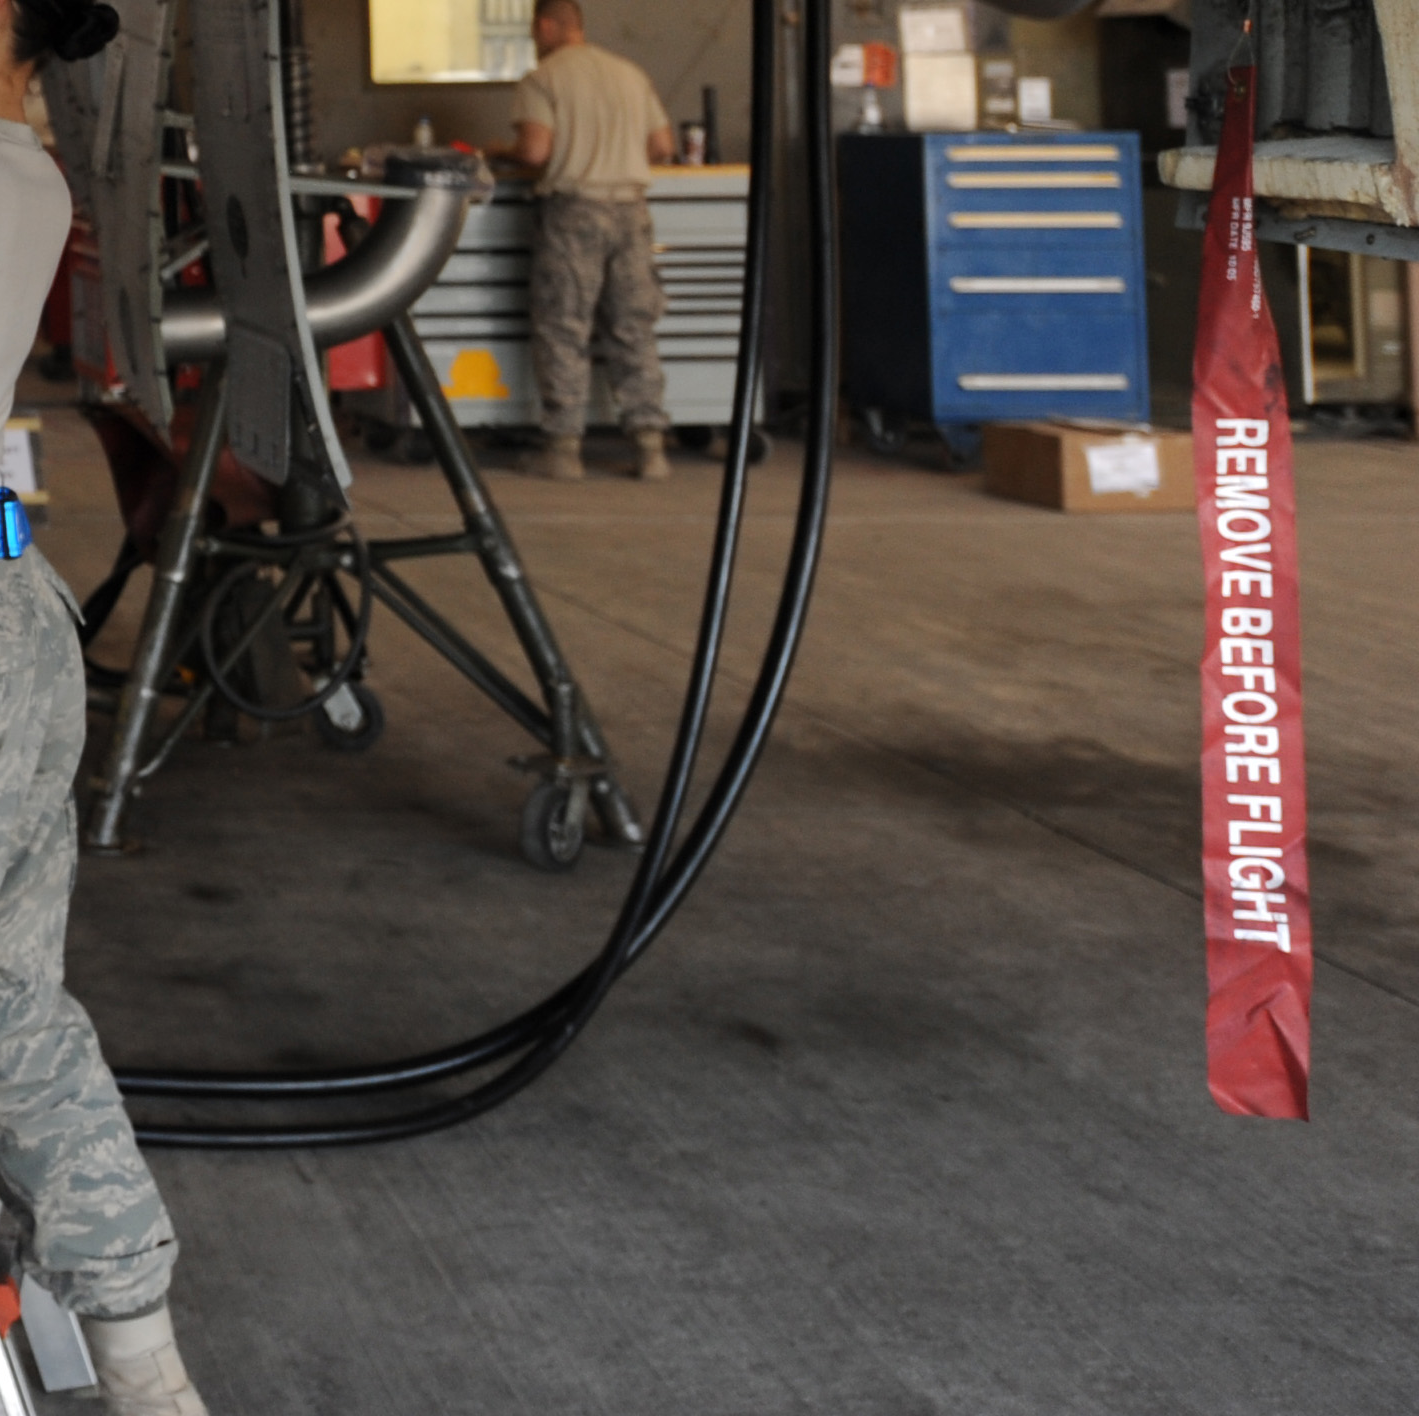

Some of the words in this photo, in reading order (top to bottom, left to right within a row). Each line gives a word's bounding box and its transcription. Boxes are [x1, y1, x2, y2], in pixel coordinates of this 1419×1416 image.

[1228, 221, 1240, 249] DATE
[1214, 417, 1274, 599] REMOVE
[1219, 606, 1281, 785] BEFORE
[1226, 793, 1292, 954] FLIGHT
